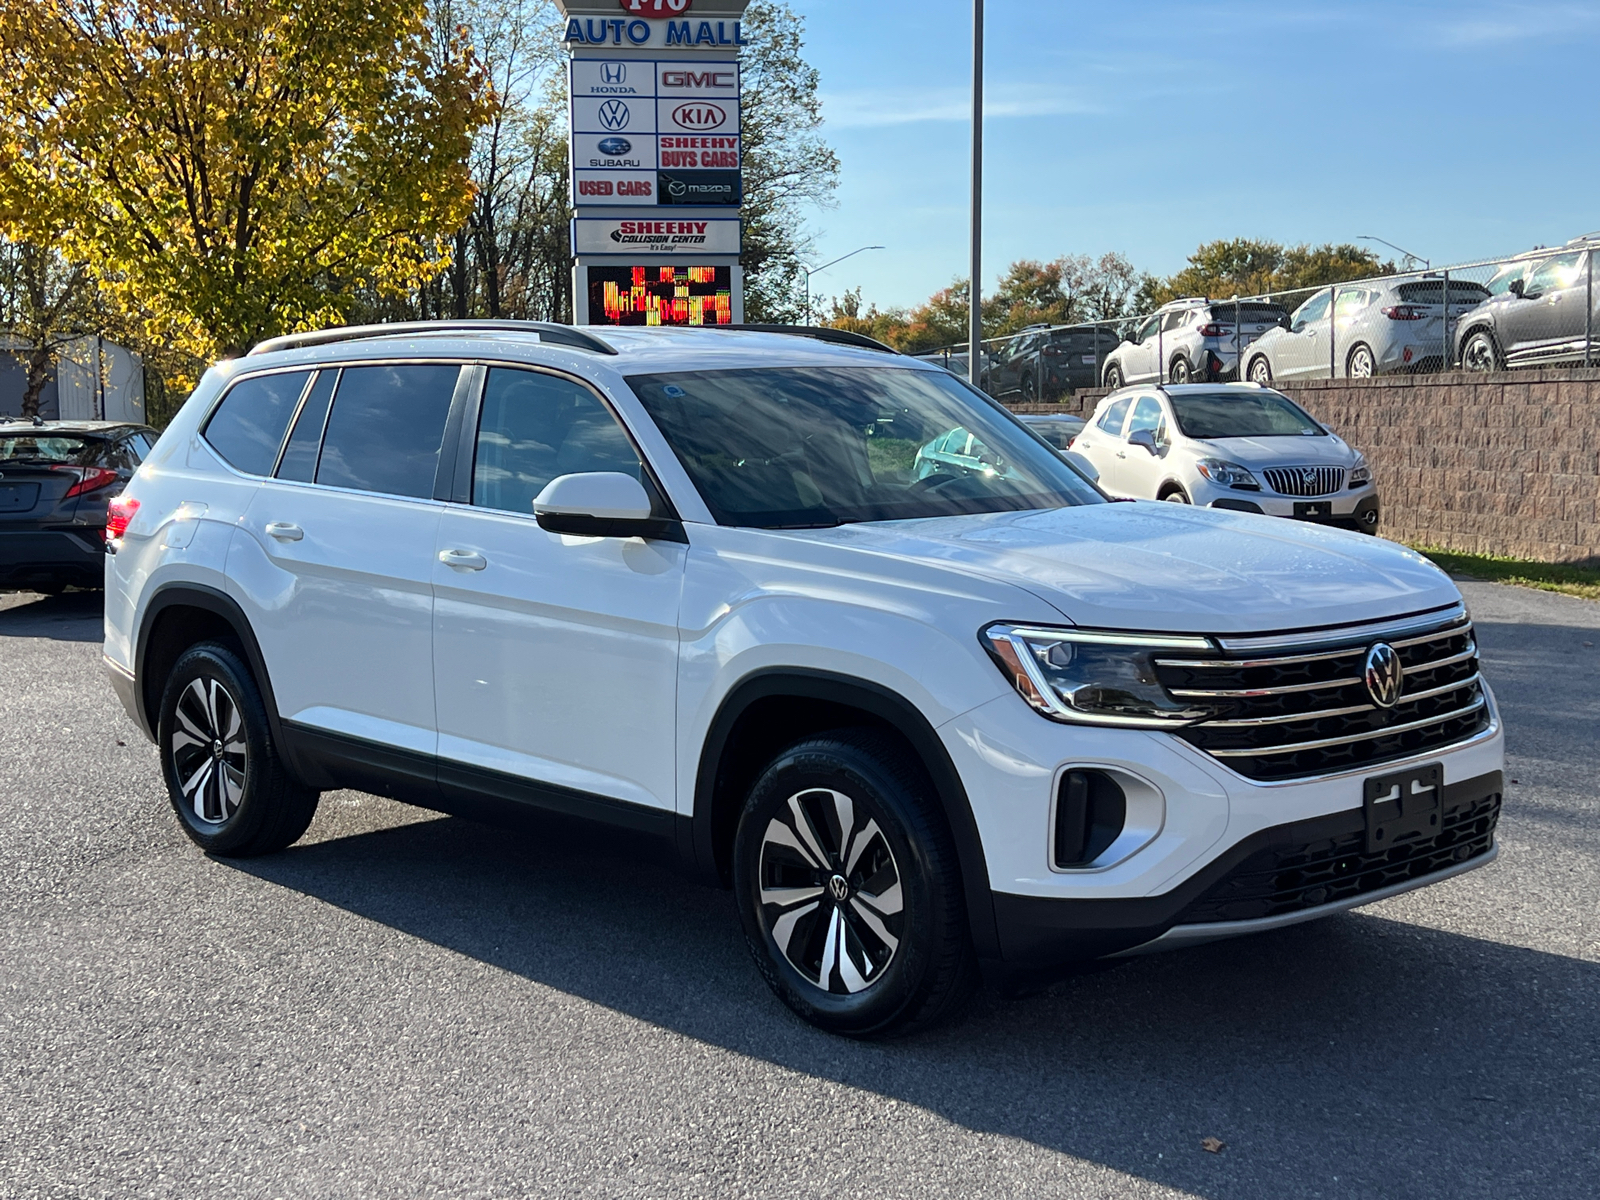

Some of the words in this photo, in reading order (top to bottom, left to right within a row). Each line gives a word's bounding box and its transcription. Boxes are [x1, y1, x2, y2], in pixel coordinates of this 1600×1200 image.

[564, 19, 650, 44] AUTO
[666, 20, 748, 46] MALL
[662, 71, 735, 88] GMC
[590, 86, 637, 94] HONDA
[681, 108, 718, 124] KIA
[660, 137, 738, 149] SHEEHY
[590, 159, 640, 167] SUBARU
[661, 151, 697, 168] BUYS
[701, 151, 738, 168] CARS
[579, 180, 613, 196] USED
[617, 181, 652, 196] CARS
[620, 222, 708, 234] SHEEHY
[621, 235, 671, 244] COLLISION
[671, 235, 706, 244] CENTER
